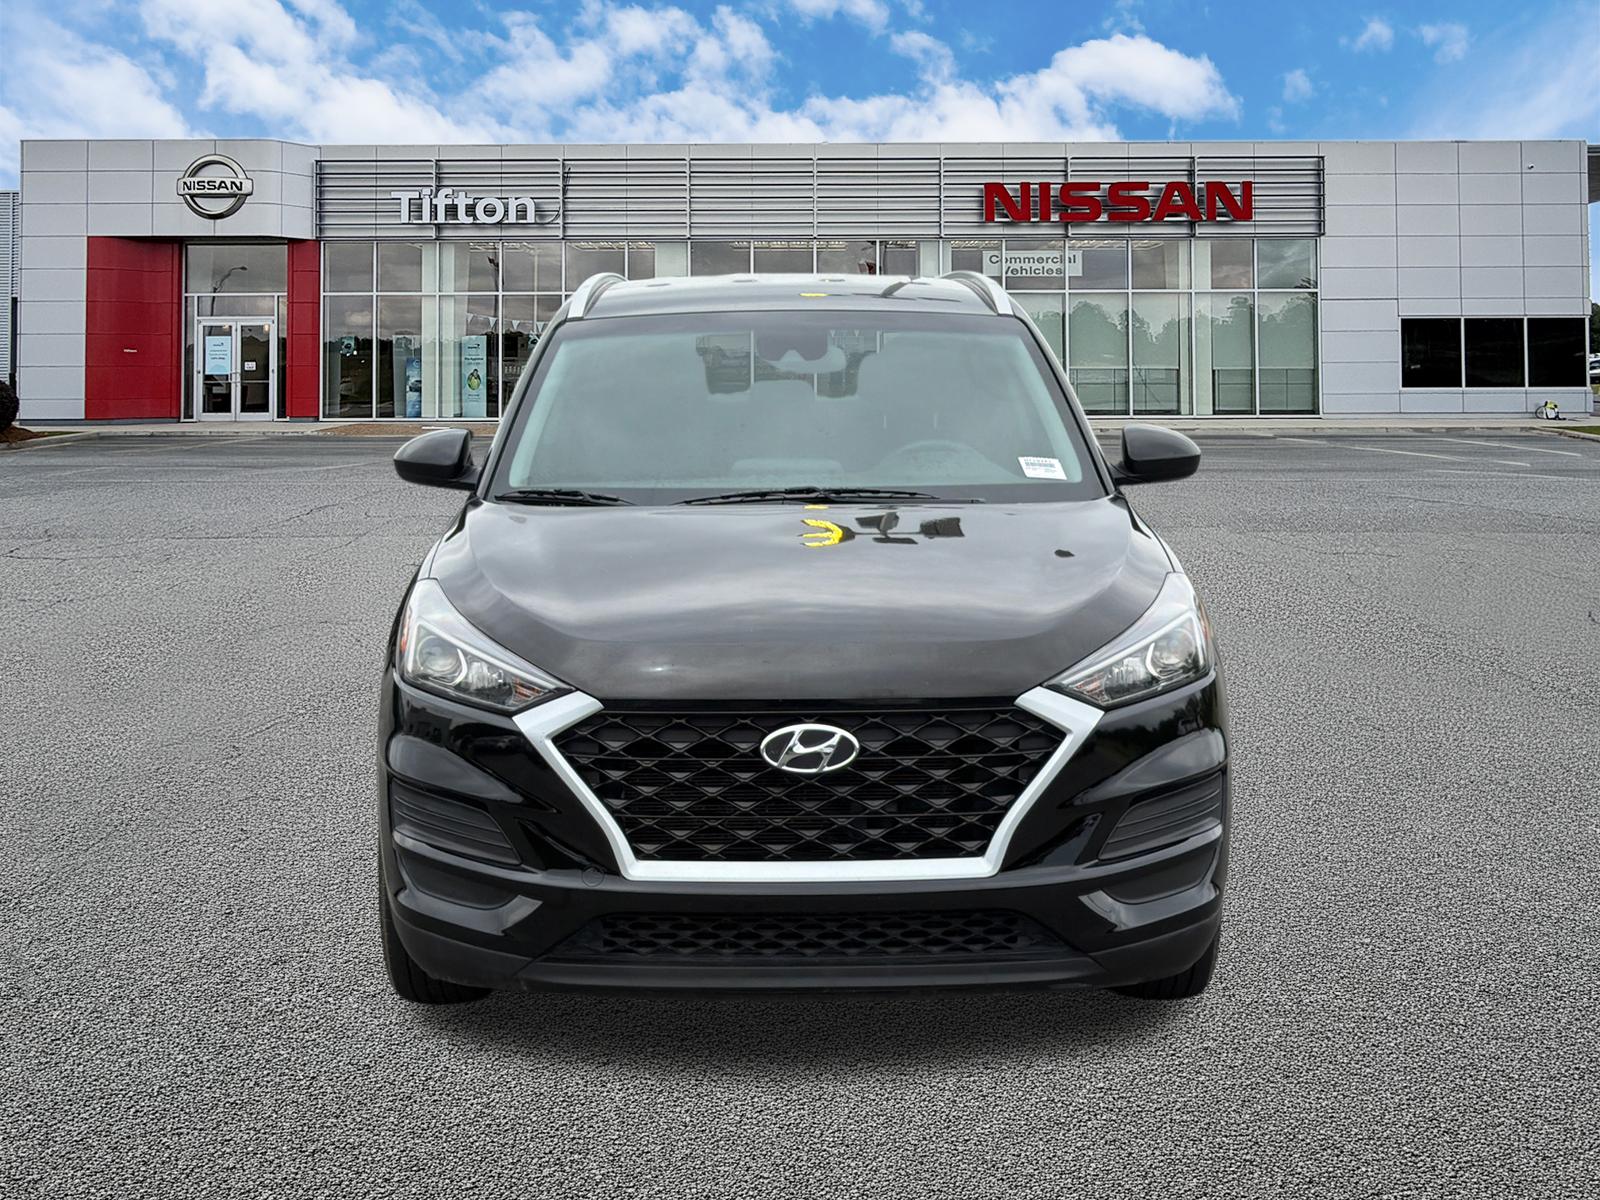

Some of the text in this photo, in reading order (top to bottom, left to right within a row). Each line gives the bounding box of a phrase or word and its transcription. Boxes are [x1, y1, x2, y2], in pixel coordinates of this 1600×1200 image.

[182, 180, 243, 191] NISSAN
[983, 181, 1253, 222] NISSAN
[390, 187, 536, 224] Tifton
